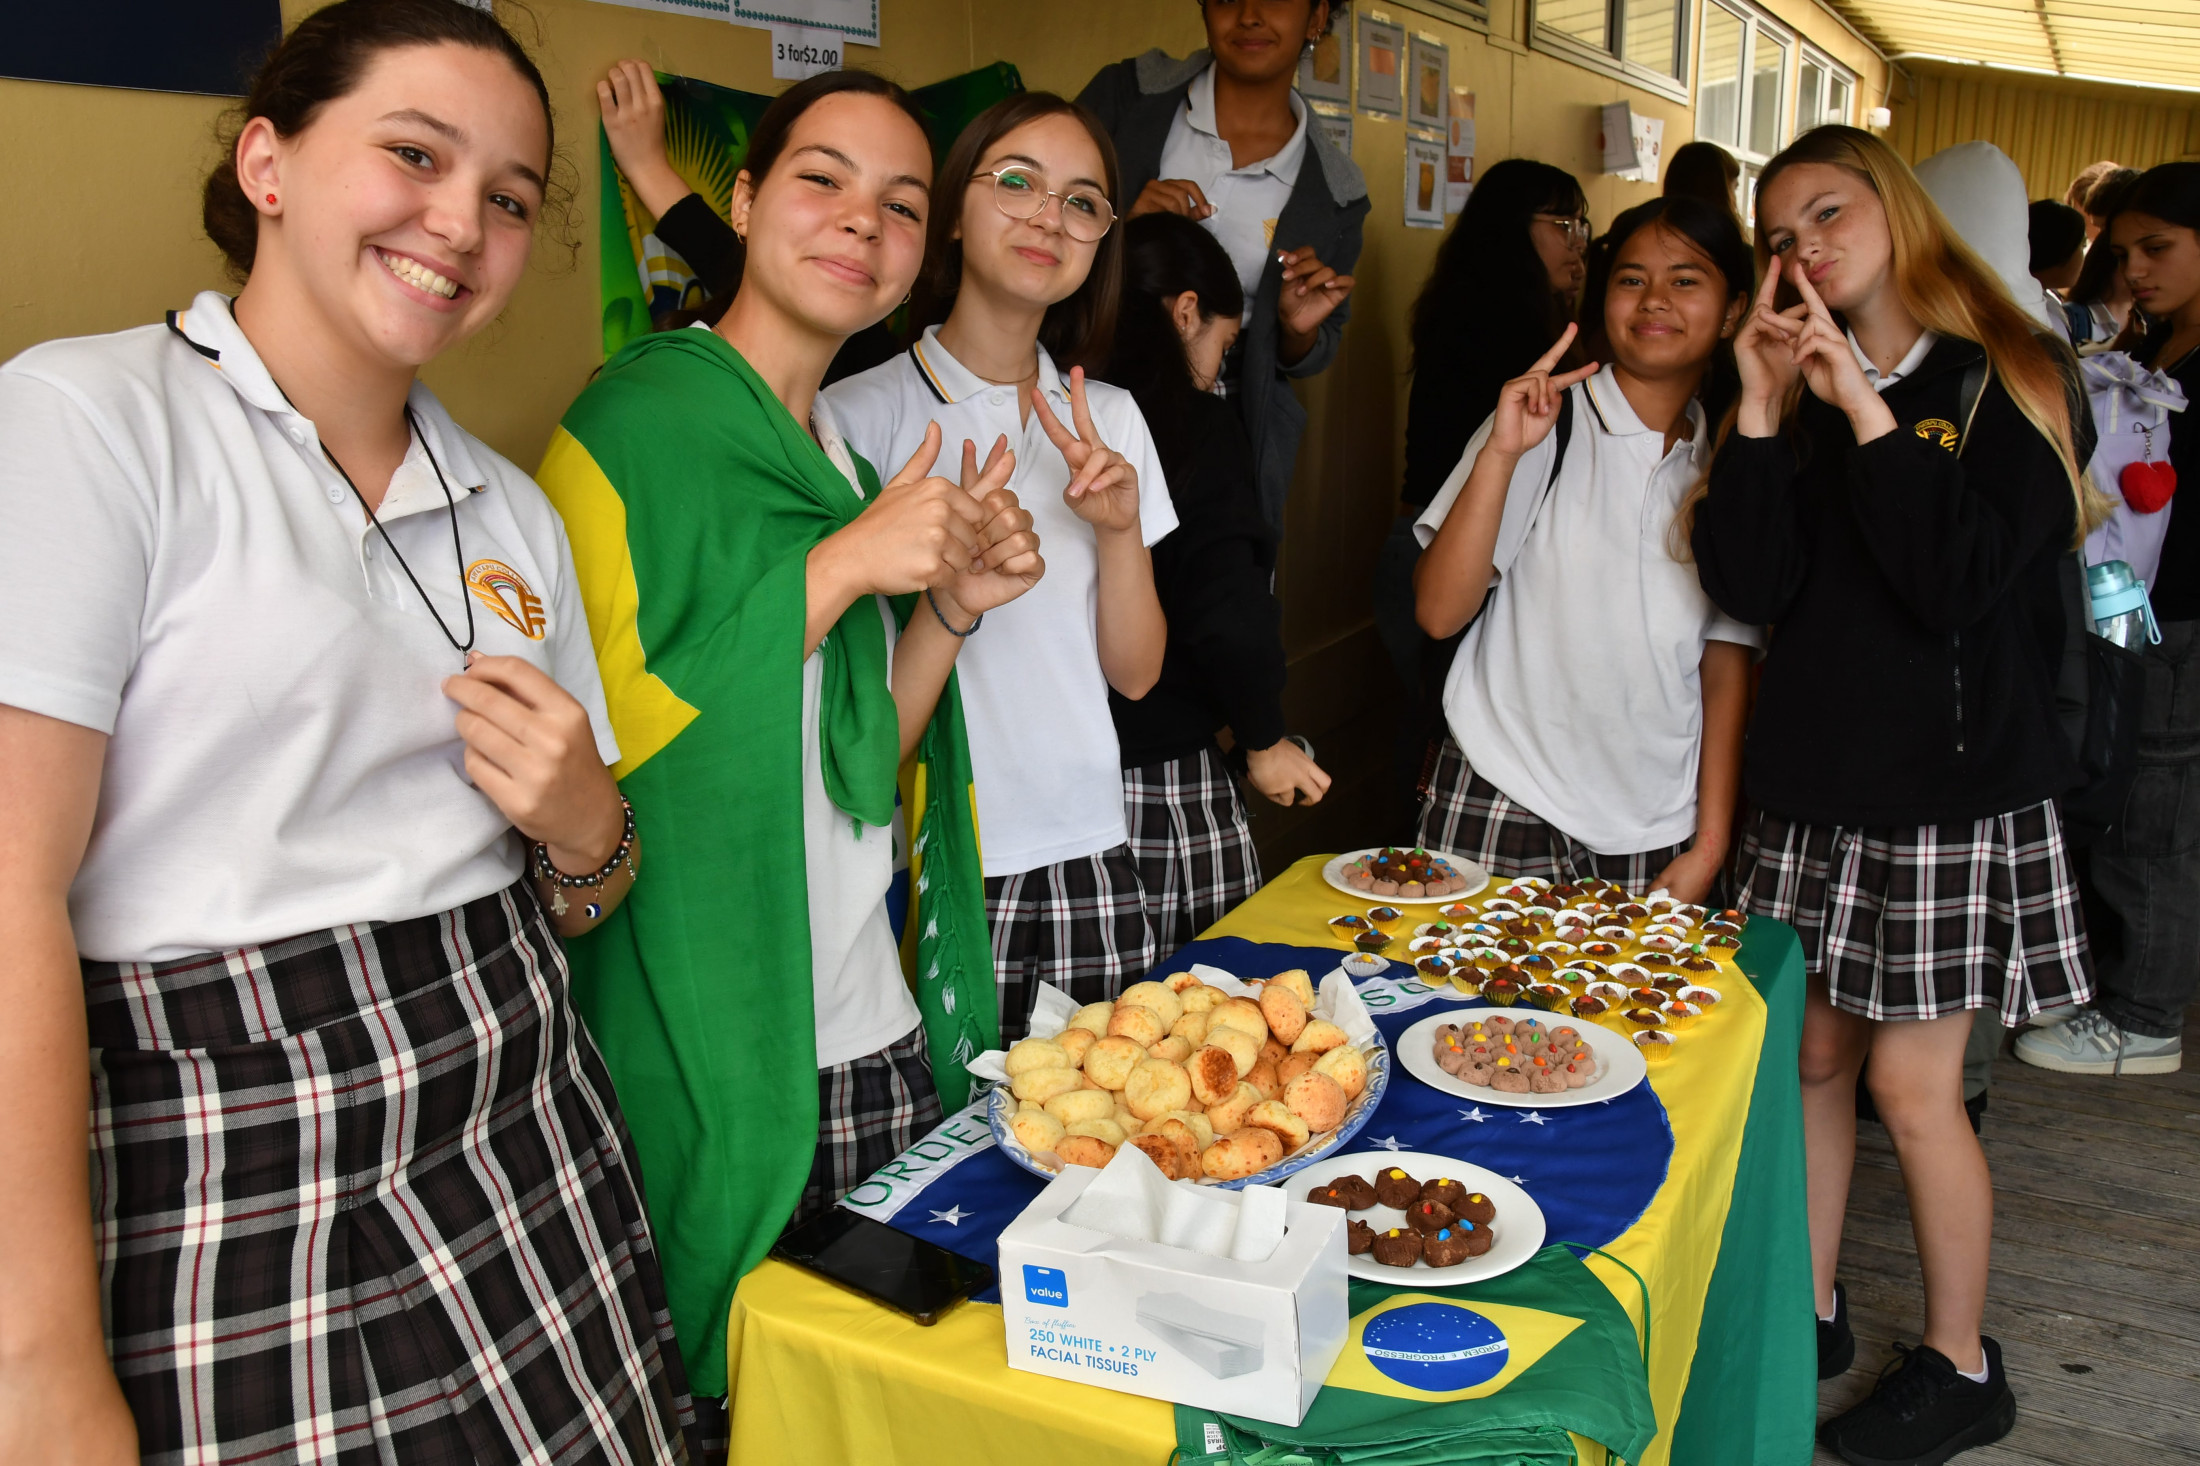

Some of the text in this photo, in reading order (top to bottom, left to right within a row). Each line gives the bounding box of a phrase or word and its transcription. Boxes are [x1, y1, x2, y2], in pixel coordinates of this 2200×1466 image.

[777, 43, 838, 67] 3 for$2.00
[1030, 1287, 1063, 1299] value
[1029, 1328, 1157, 1363] 250 WHITE 2 PLY
[1374, 1348, 1446, 1361] PROGRESSO
[1463, 1343, 1501, 1358] ORDEM
[1030, 1344, 1139, 1377] FACIAL TISSUES
